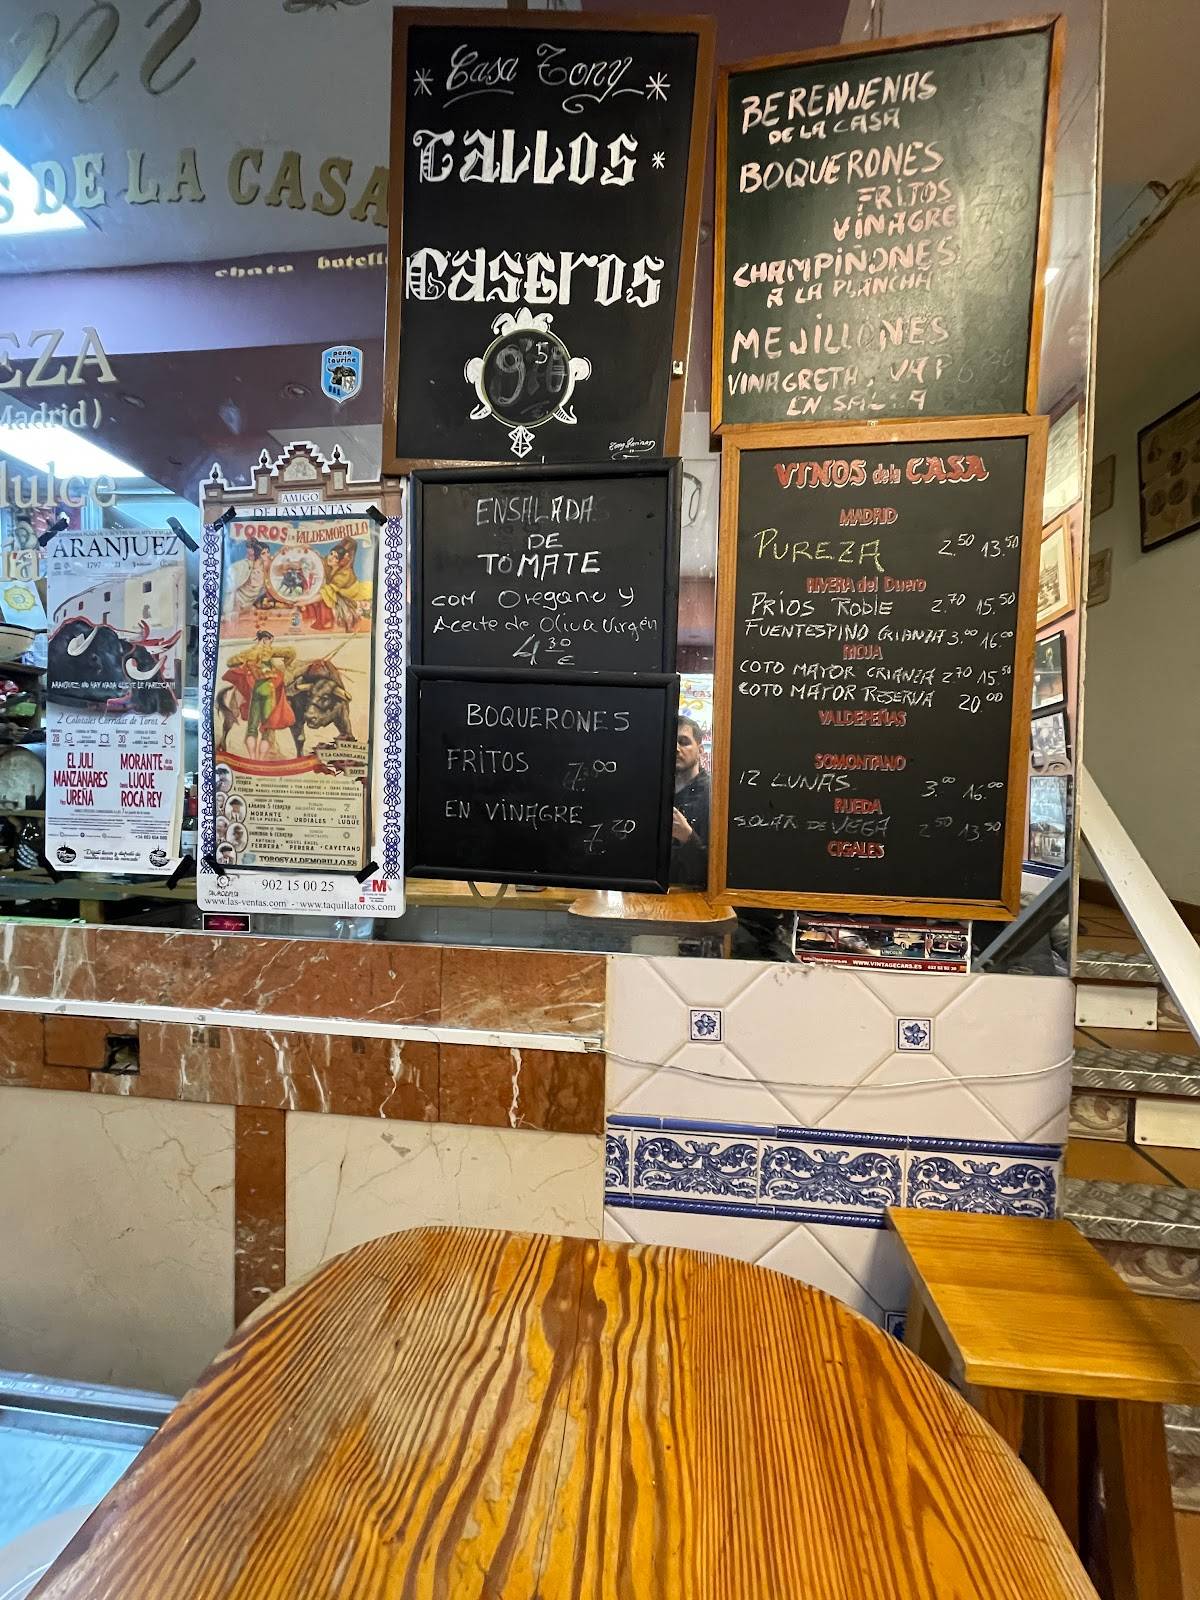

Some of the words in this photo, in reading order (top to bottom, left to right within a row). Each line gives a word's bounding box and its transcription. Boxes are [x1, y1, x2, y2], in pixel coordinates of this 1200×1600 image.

[742, 70, 938, 134] BERENJENAS
[769, 124, 792, 144] DE
[800, 119, 826, 140] LA
[833, 108, 900, 134] CASA
[739, 141, 944, 193] BOQUERONES
[32, 153, 107, 216] DE
[126, 148, 206, 205] LA
[228, 148, 389, 227] CASA
[857, 177, 953, 212] FRITOS
[833, 205, 958, 241] VINAGRE
[317, 252, 387, 270] botell
[767, 288, 783, 307] A
[795, 285, 822, 303] LA
[774, 457, 867, 489] VINOS
[906, 454, 990, 484] CASA
[282, 493, 320, 503] AMIGO
[476, 495, 594, 526] ENSALADA
[839, 507, 899, 527] MADRID
[233, 523, 289, 543] TOROS
[296, 521, 368, 544] VALDEMORILLO
[528, 532, 563, 550] DE
[53, 536, 179, 561] ARANJUEZ
[753, 527, 885, 573] PUREZA
[477, 550, 601, 581] TOMATE
[505, 615, 529, 632] de
[739, 659, 785, 675] COTO
[738, 681, 783, 697] COTO
[467, 703, 630, 733] BOQUERONES
[818, 708, 908, 727] VALDEPEÑAS
[67, 752, 75, 769] EL
[78, 752, 94, 769] JULI
[120, 753, 163, 770] MORANTE
[447, 744, 529, 774] FRITOS
[814, 753, 907, 773] SOMONTANO
[53, 770, 108, 787] MANZANARES
[128, 772, 155, 789] LUQUE
[66, 787, 94, 806] UREÑA
[121, 791, 144, 807] ROCA
[146, 792, 162, 808] REY
[445, 799, 470, 818] EN
[485, 798, 583, 830] VINAGRE
[834, 798, 883, 815] RUEDA
[827, 840, 885, 859] CIGALES
[262, 879, 282, 891] 902
[287, 880, 300, 891] 15
[303, 880, 317, 892] 00
[321, 881, 335, 892] 25
[204, 898, 287, 907] www.las-ventas.com
[300, 902, 396, 912] www.taquillatoros.com
[852, 959, 923, 970] WWW.VINTAGECARS.ES
